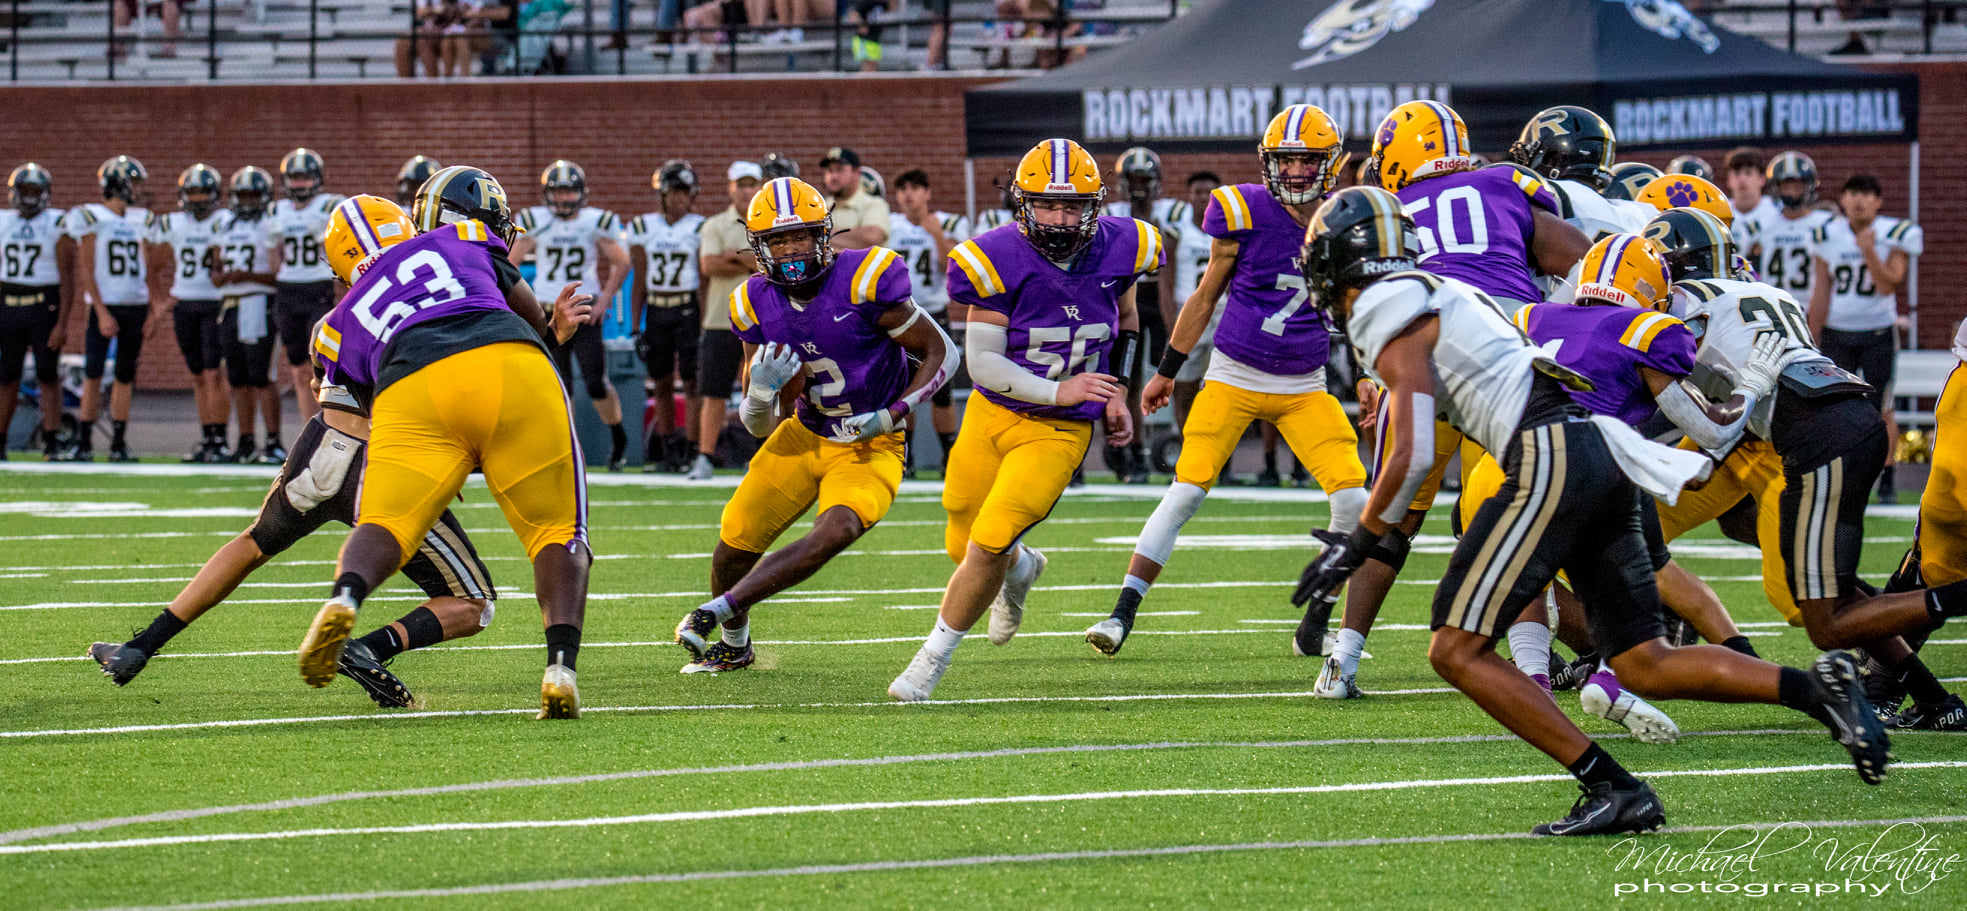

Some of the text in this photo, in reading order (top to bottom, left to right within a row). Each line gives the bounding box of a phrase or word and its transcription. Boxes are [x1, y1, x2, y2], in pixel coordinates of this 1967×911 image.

[1084, 86, 1451, 139] ROCKMART FOTB
[1531, 109, 1571, 143] R
[1615, 91, 1904, 143] ROCKMART FOOTBALL
[474, 177, 508, 219] R
[775, 215, 799, 225] Riddell
[1403, 185, 1489, 264] 50
[5, 243, 41, 277] 67
[108, 240, 139, 277] 69
[285, 235, 319, 266] 38
[546, 247, 585, 281] 72
[652, 252, 688, 286] 37
[1768, 247, 1810, 290] 43
[1835, 264, 1875, 296] 90
[351, 249, 466, 344] 53
[1261, 273, 1309, 337] 7
[1581, 285, 1625, 303] Riddell
[1061, 304, 1083, 321] VR
[800, 341, 823, 356] VR
[1025, 322, 1111, 382] 56
[803, 357, 853, 417] 2
